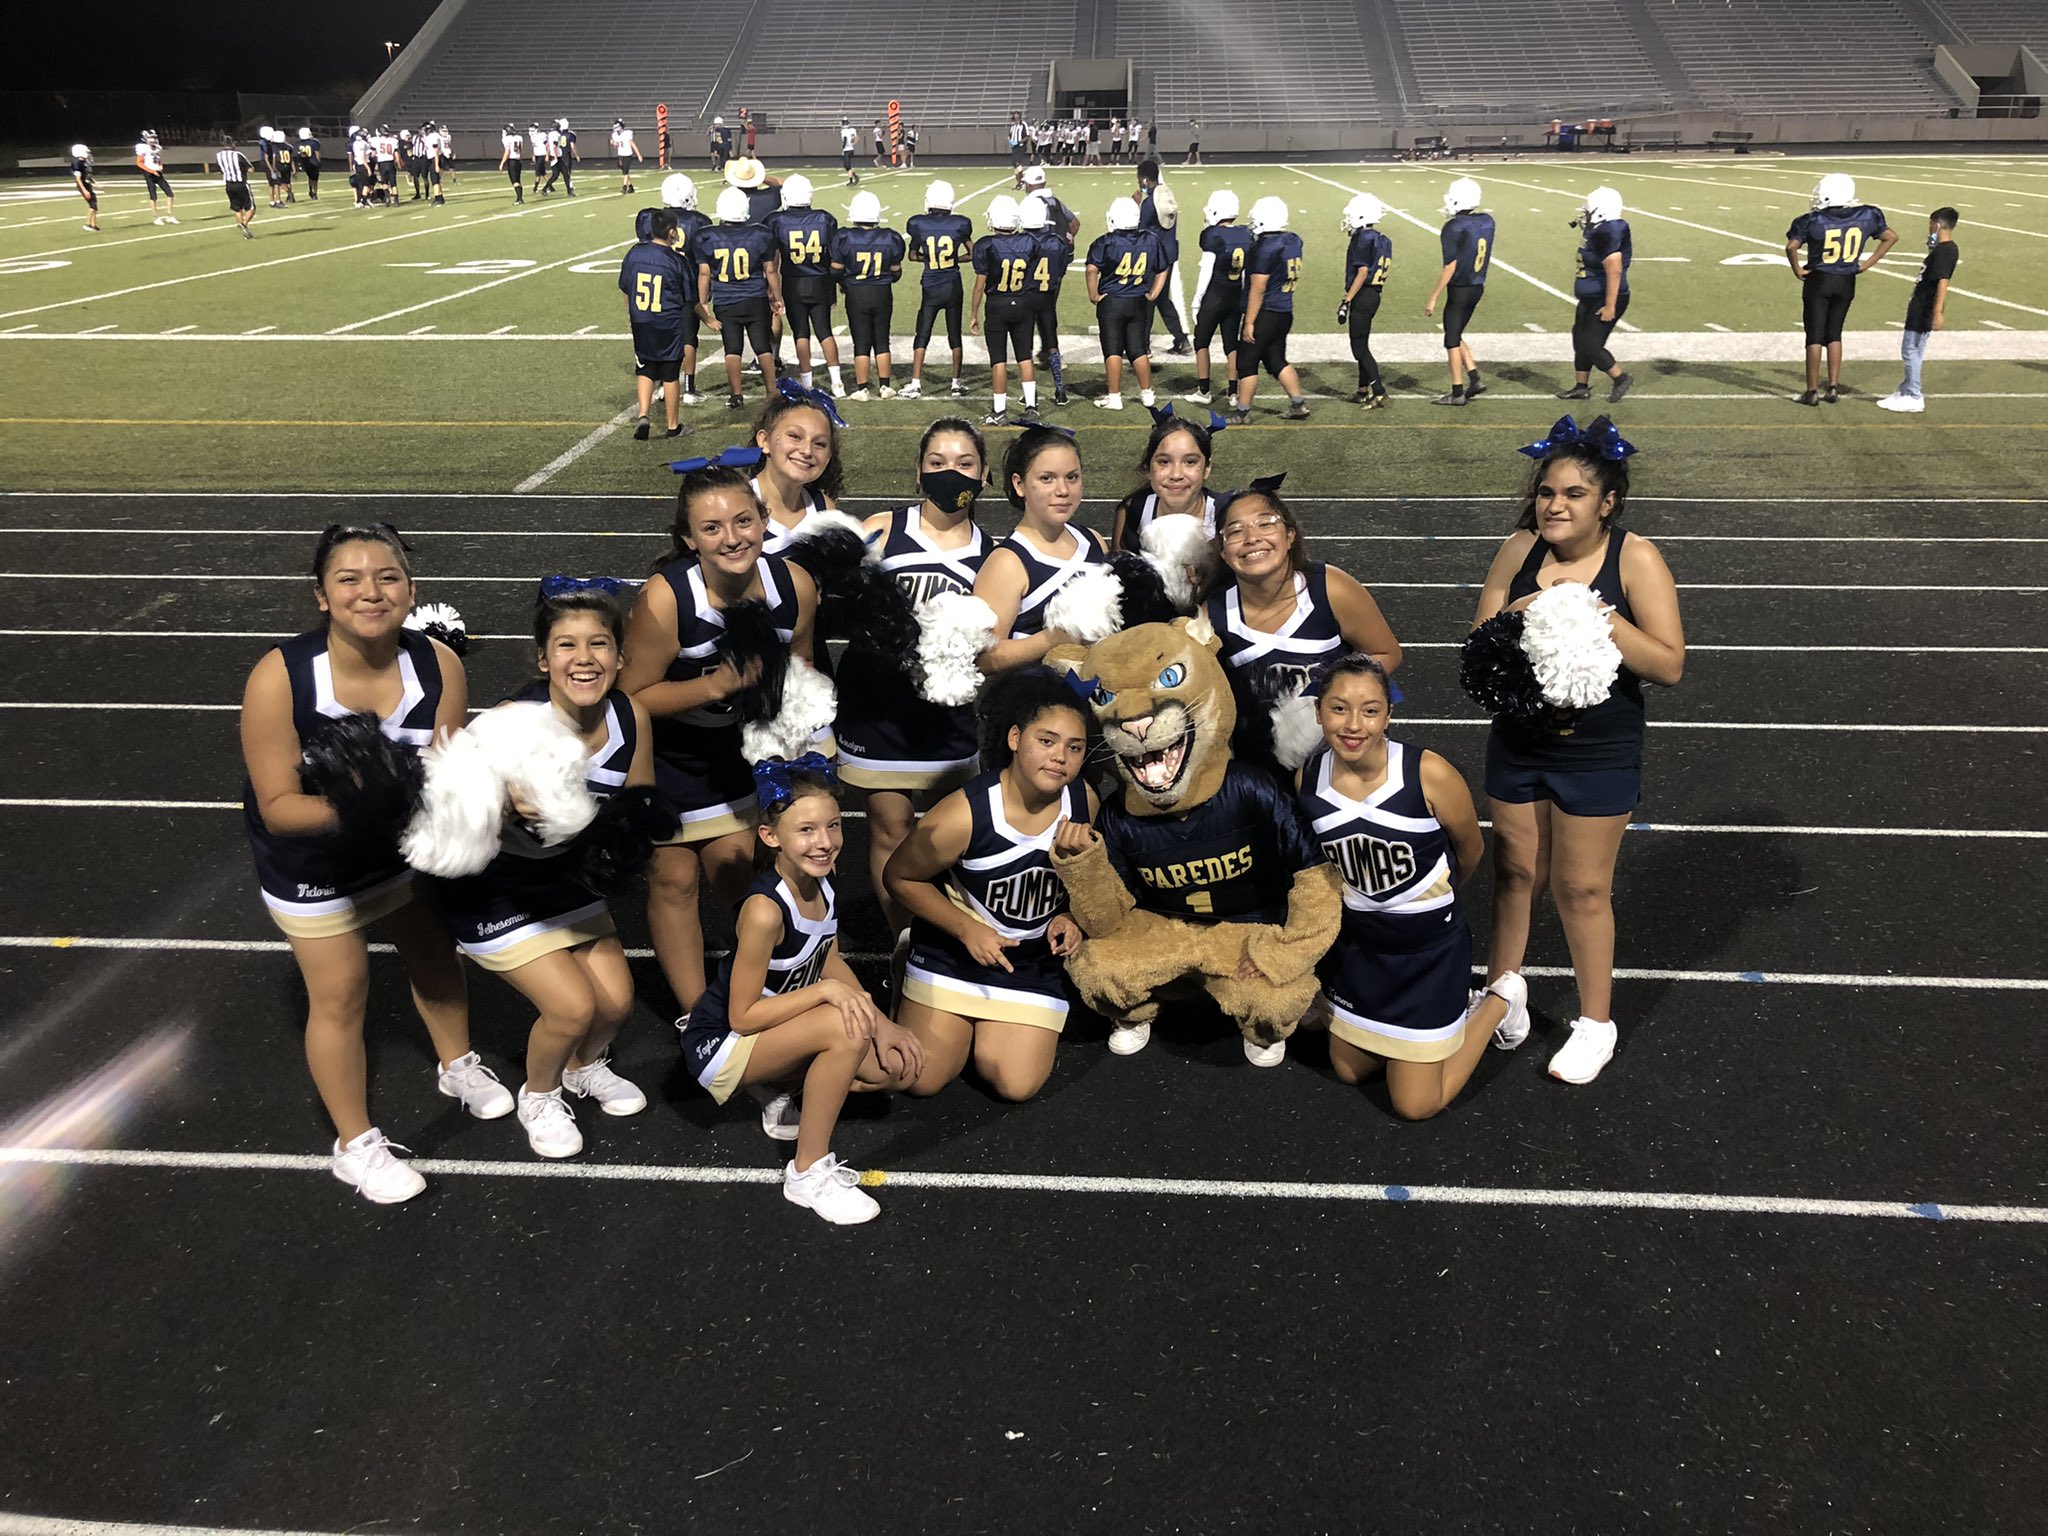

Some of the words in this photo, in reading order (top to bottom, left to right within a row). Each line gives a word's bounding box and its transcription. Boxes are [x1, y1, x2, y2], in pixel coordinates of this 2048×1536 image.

[279, 150, 291, 164] 10
[789, 229, 823, 265] 54
[926, 236, 955, 270] 12
[1472, 238, 1487, 273] 8
[1822, 227, 1863, 265] 50
[713, 247, 750, 283] 70
[856, 251, 883, 280] 71
[1114, 252, 1148, 286] 44
[635, 272, 663, 313] 51
[896, 572, 972, 612] PUM
[1138, 844, 1253, 889] PAREDES
[1322, 832, 1416, 896] PUMAS
[297, 882, 336, 898] Victoria
[1185, 890, 1213, 914] 1
[695, 1036, 721, 1060] Taylor
